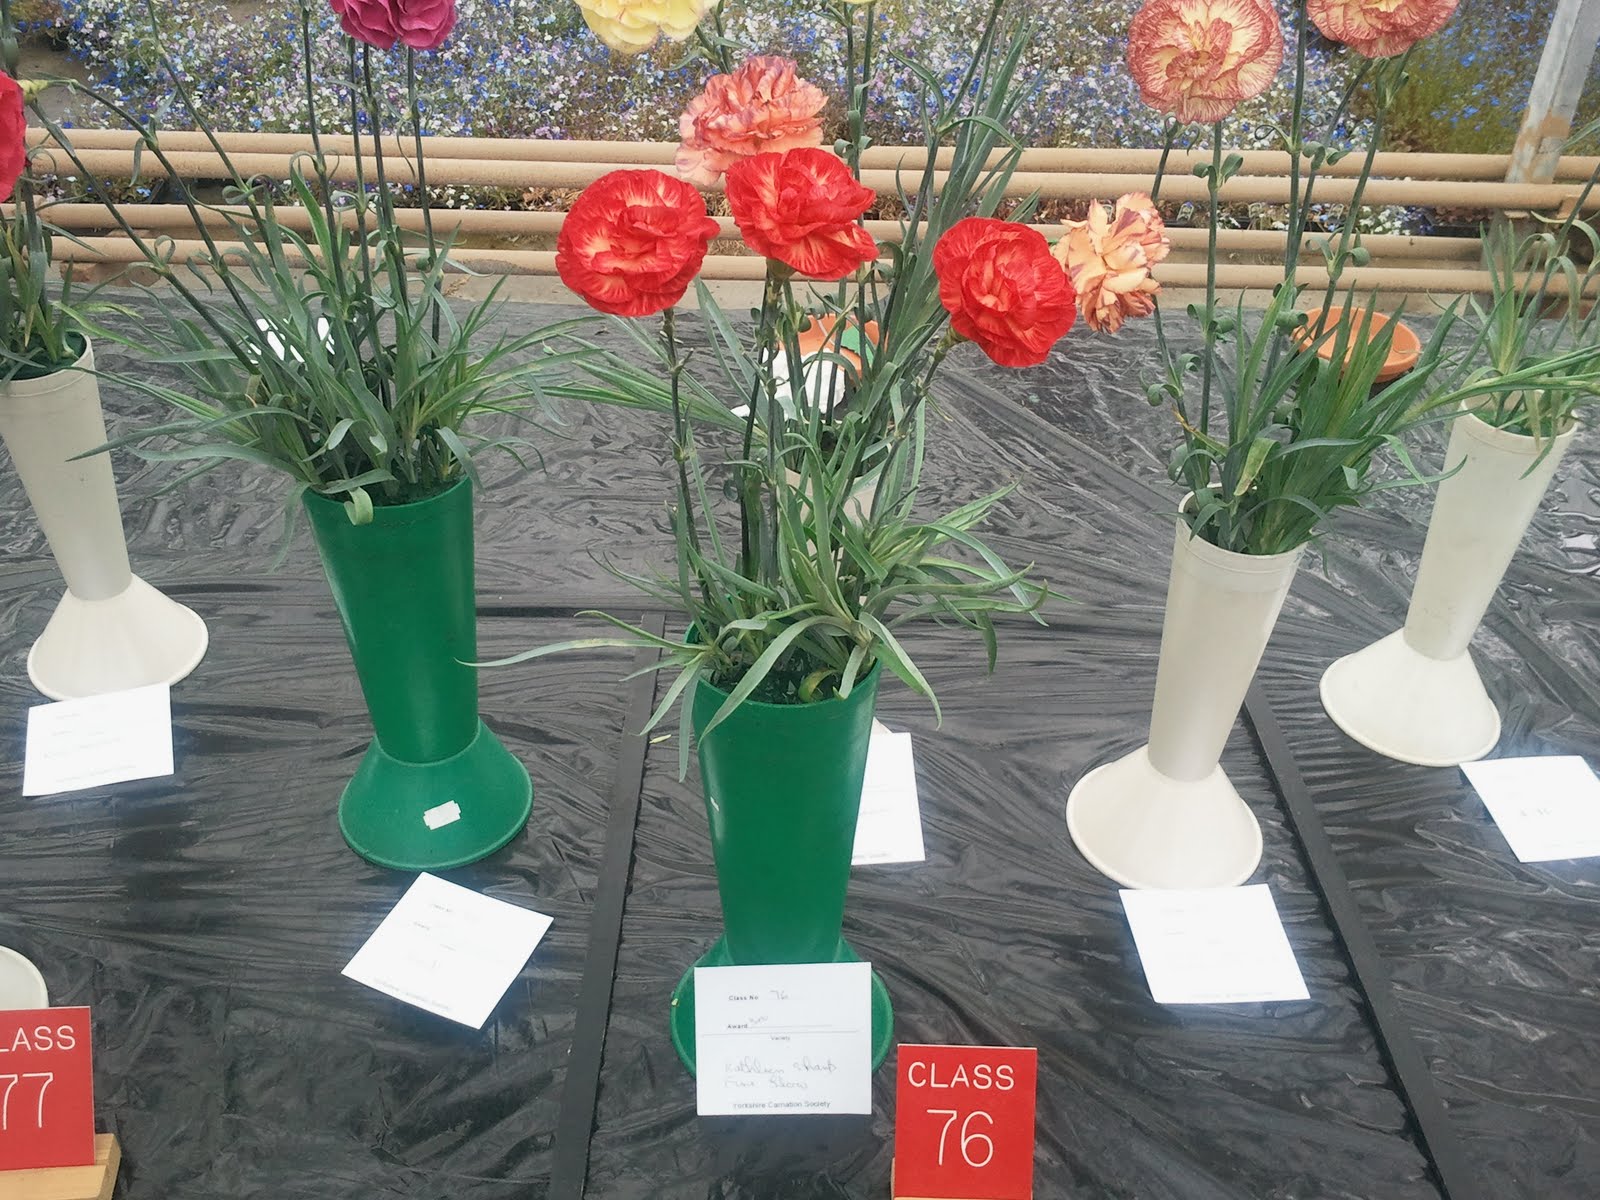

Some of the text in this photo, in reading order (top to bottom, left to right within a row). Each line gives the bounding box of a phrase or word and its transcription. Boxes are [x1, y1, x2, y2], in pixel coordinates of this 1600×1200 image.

[907, 1061, 1015, 1091] CLASS
[804, 1100, 831, 1109] Society
[926, 1108, 994, 1168] 76
